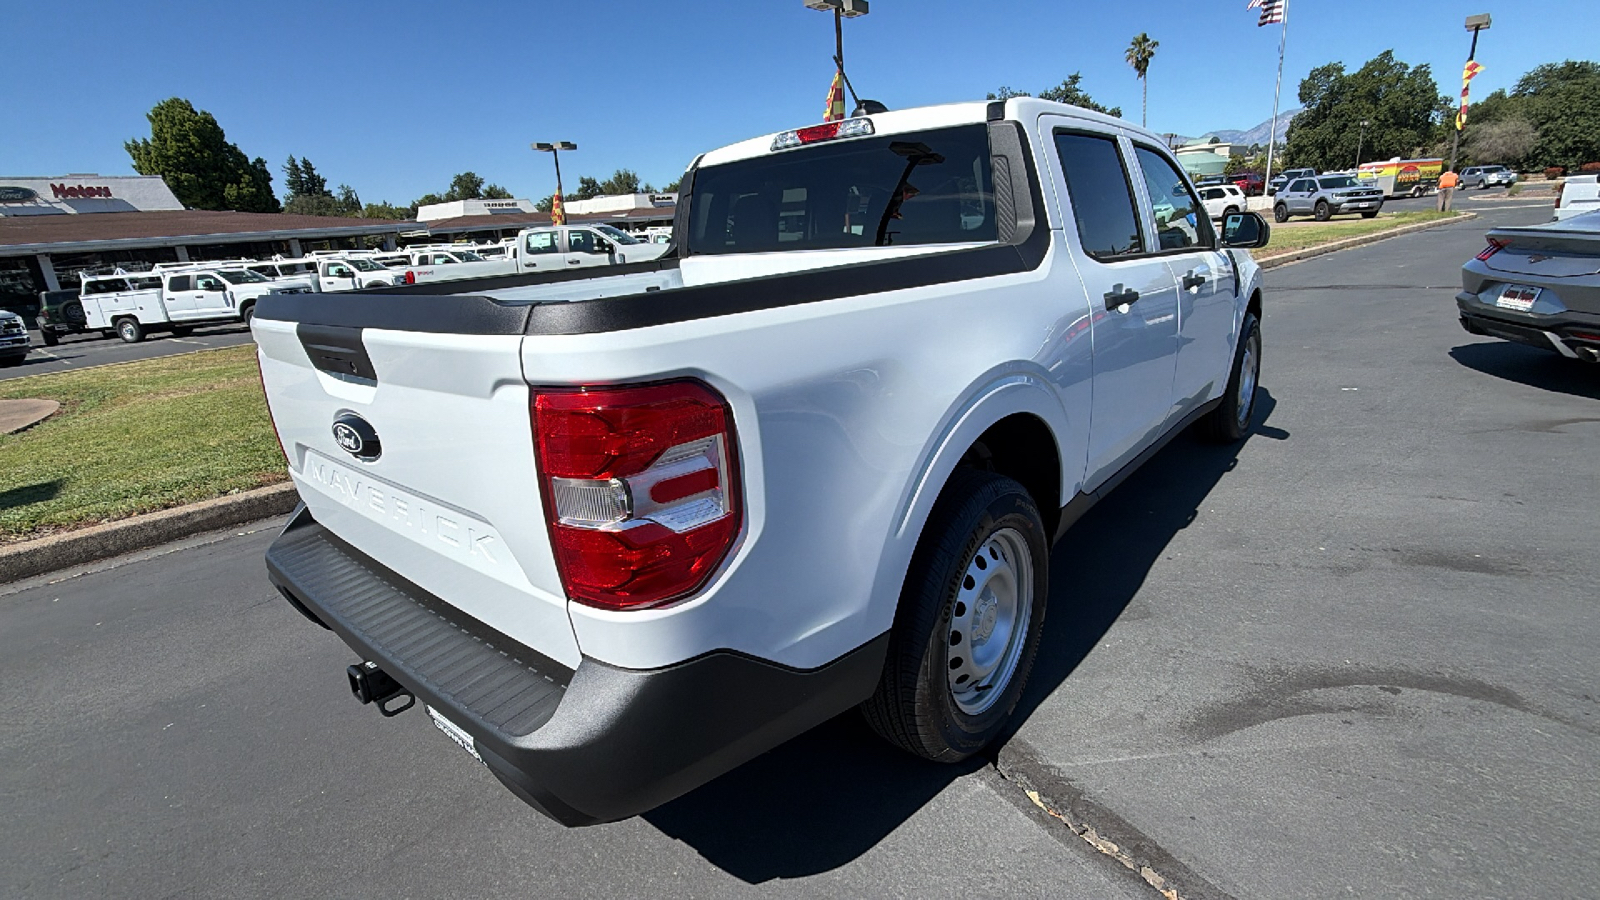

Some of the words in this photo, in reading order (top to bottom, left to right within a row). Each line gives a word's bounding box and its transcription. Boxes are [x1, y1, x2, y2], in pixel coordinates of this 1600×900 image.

[50, 183, 112, 199] Motors
[337, 426, 357, 449] Ford
[310, 460, 498, 564] MAVERICK
[941, 532, 980, 623] Continental
